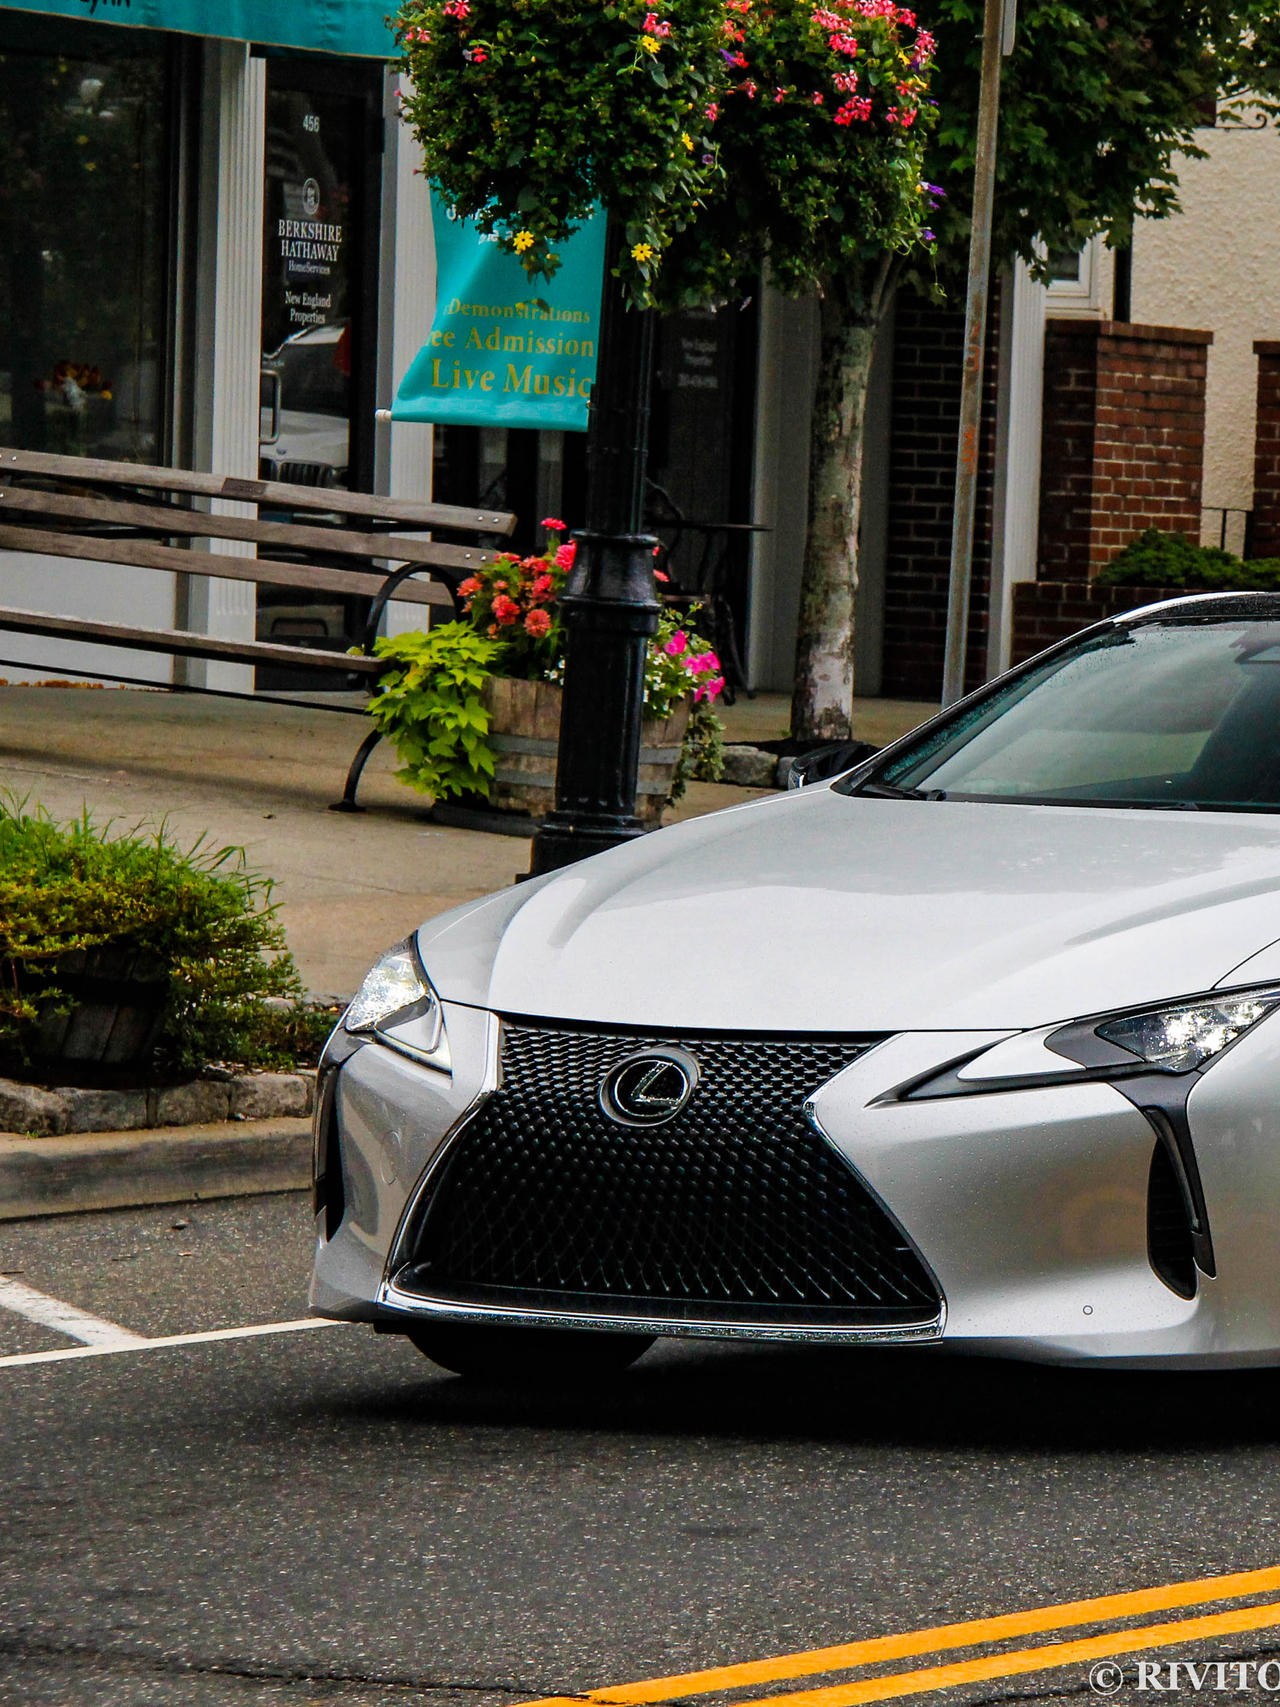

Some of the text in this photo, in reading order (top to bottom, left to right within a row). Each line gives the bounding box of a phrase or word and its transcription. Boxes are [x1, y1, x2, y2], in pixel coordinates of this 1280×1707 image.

[303, 115, 320, 132] 456
[278, 219, 342, 242] BERKSHIRE
[281, 240, 340, 261] HATHAWAY
[288, 260, 331, 275] HomeServices
[285, 291, 331, 310] New England
[447, 298, 591, 324] Demonstrations
[290, 308, 326, 325] Properties
[464, 306, 594, 358] Admission
[431, 358, 592, 397] Live Music
